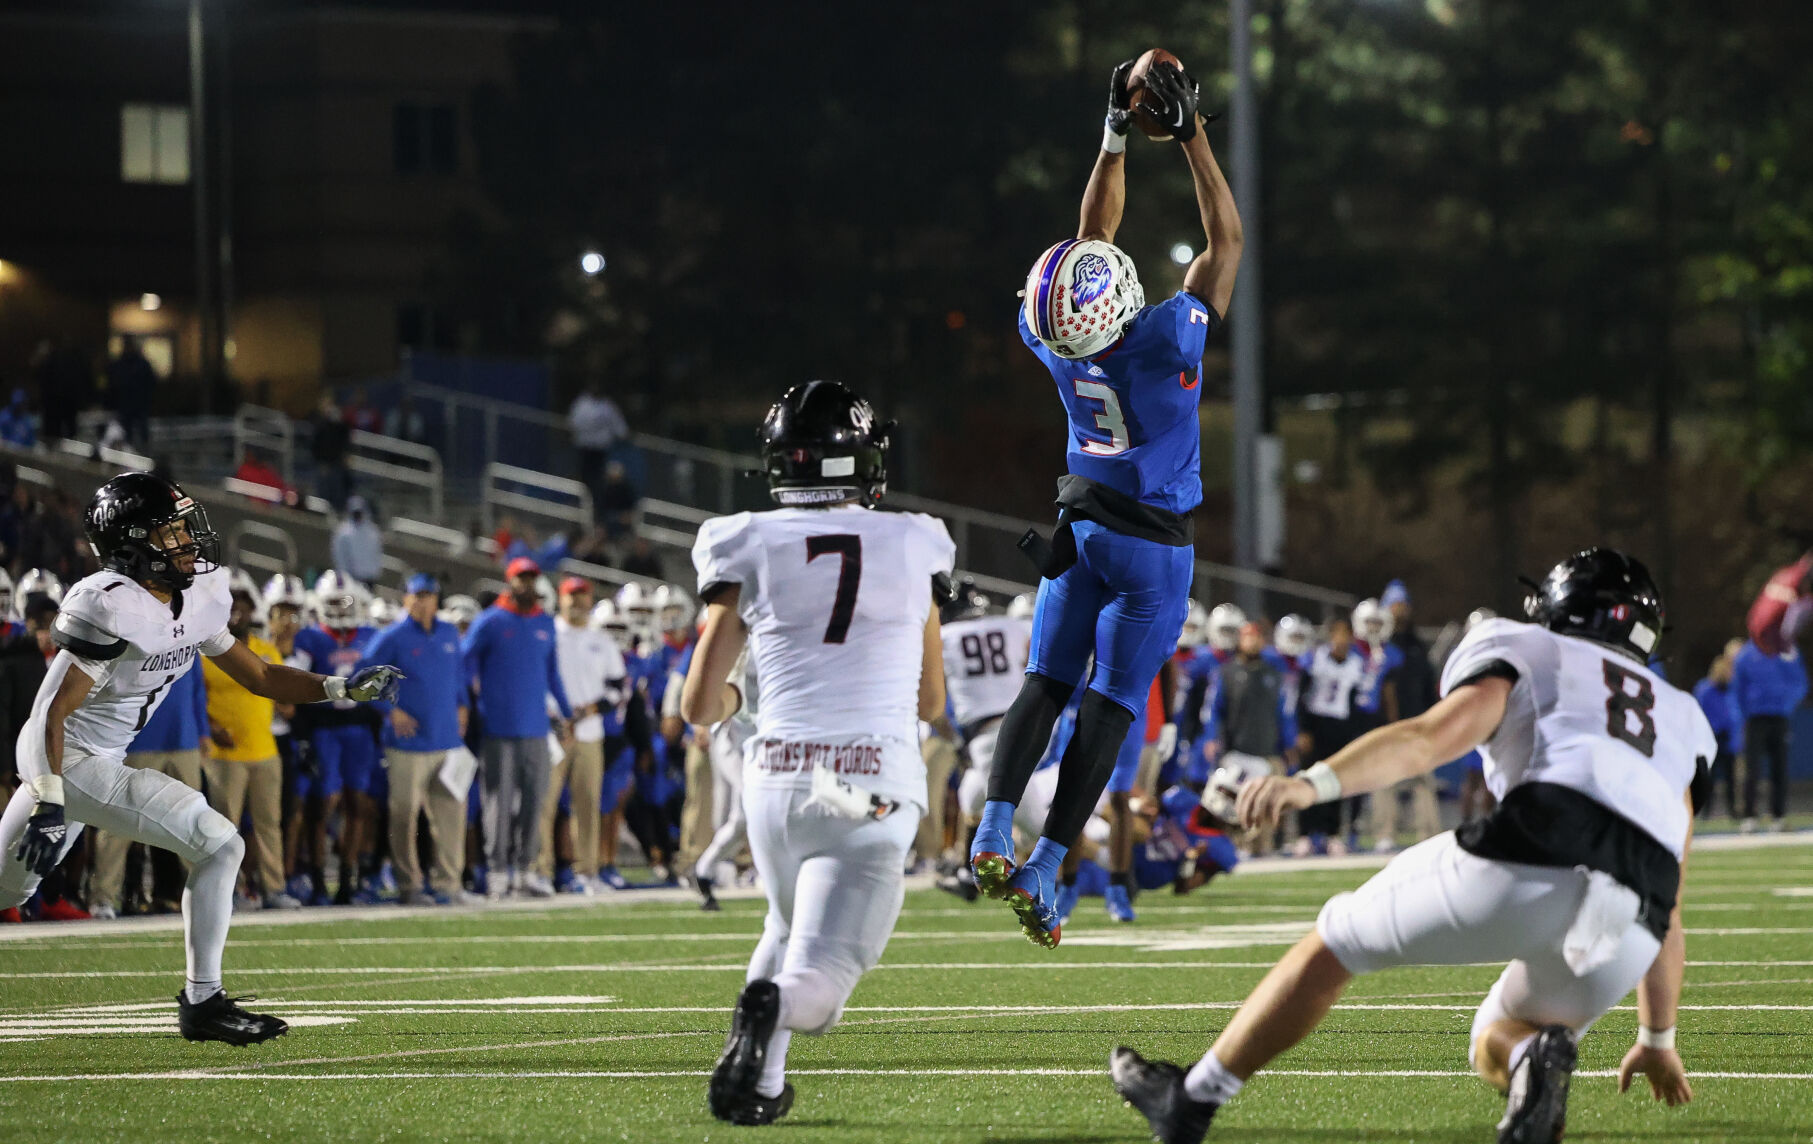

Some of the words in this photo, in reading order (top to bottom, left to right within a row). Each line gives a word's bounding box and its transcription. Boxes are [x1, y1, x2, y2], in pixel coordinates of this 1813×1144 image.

[1074, 378, 1133, 456] 3
[806, 534, 862, 644] 7
[962, 631, 1009, 676] 98
[1602, 658, 1656, 759] 8
